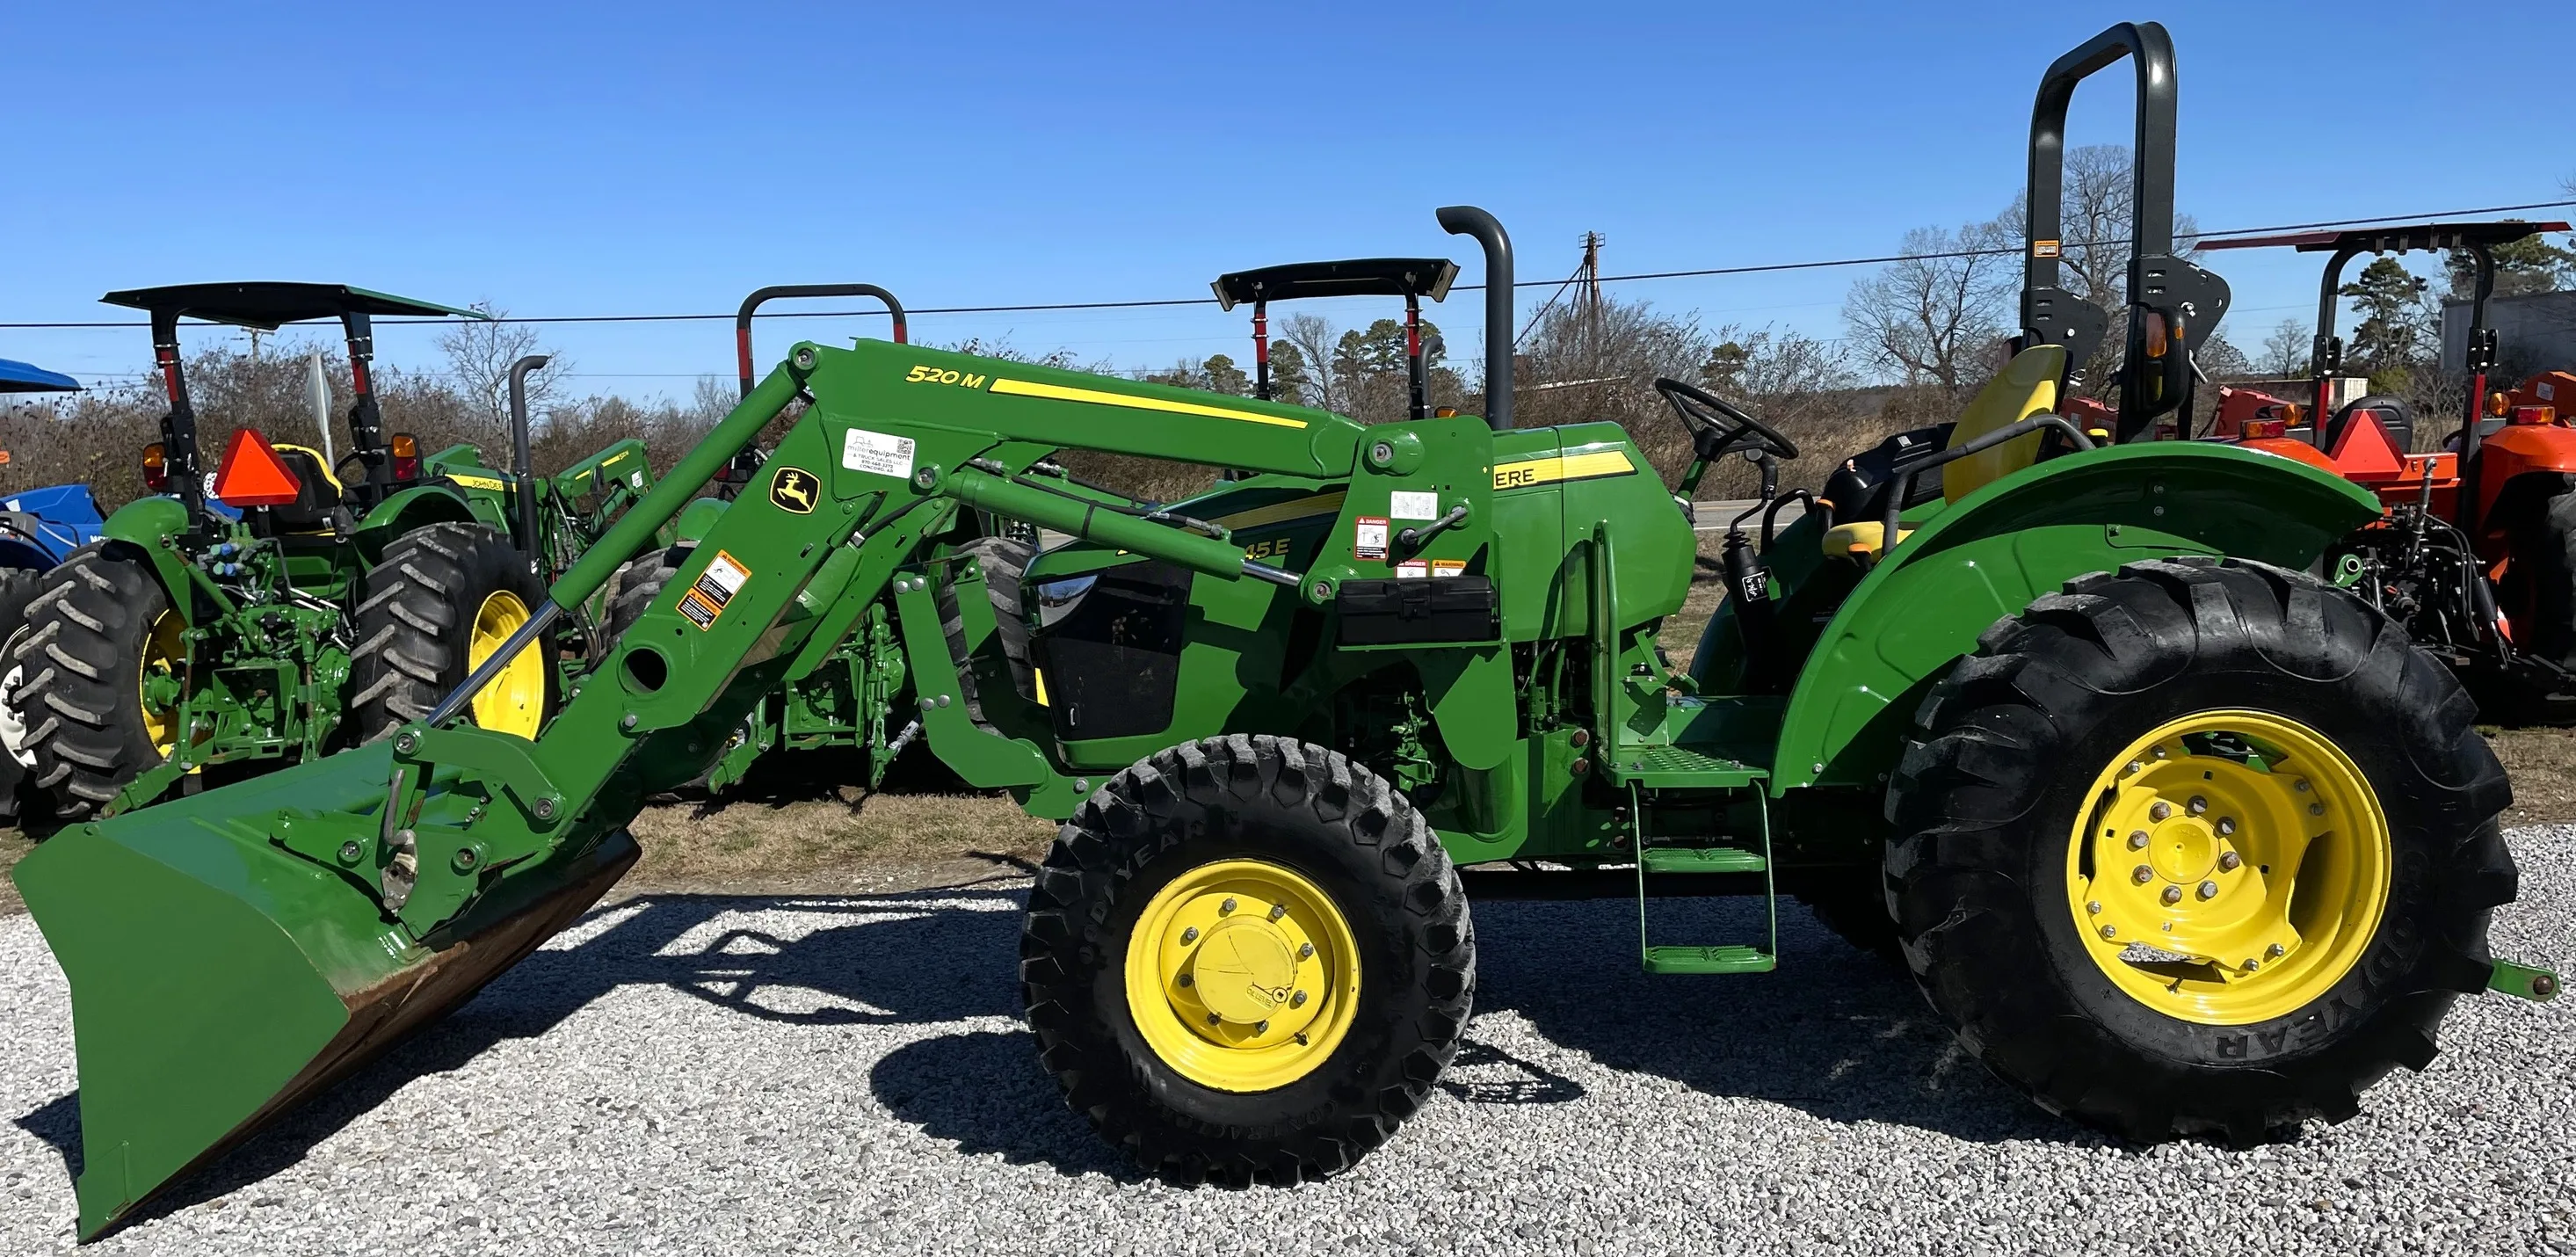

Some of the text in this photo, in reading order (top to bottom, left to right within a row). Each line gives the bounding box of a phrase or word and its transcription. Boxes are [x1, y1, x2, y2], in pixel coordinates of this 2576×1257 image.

[905, 365, 986, 389] 520 M
[490, 481, 502, 490] DEE
[1495, 469, 1535, 486] ERE
[1244, 538, 1291, 560] 45 E
[727, 556, 747, 574] WARNING
[697, 596, 717, 613] WARNING
